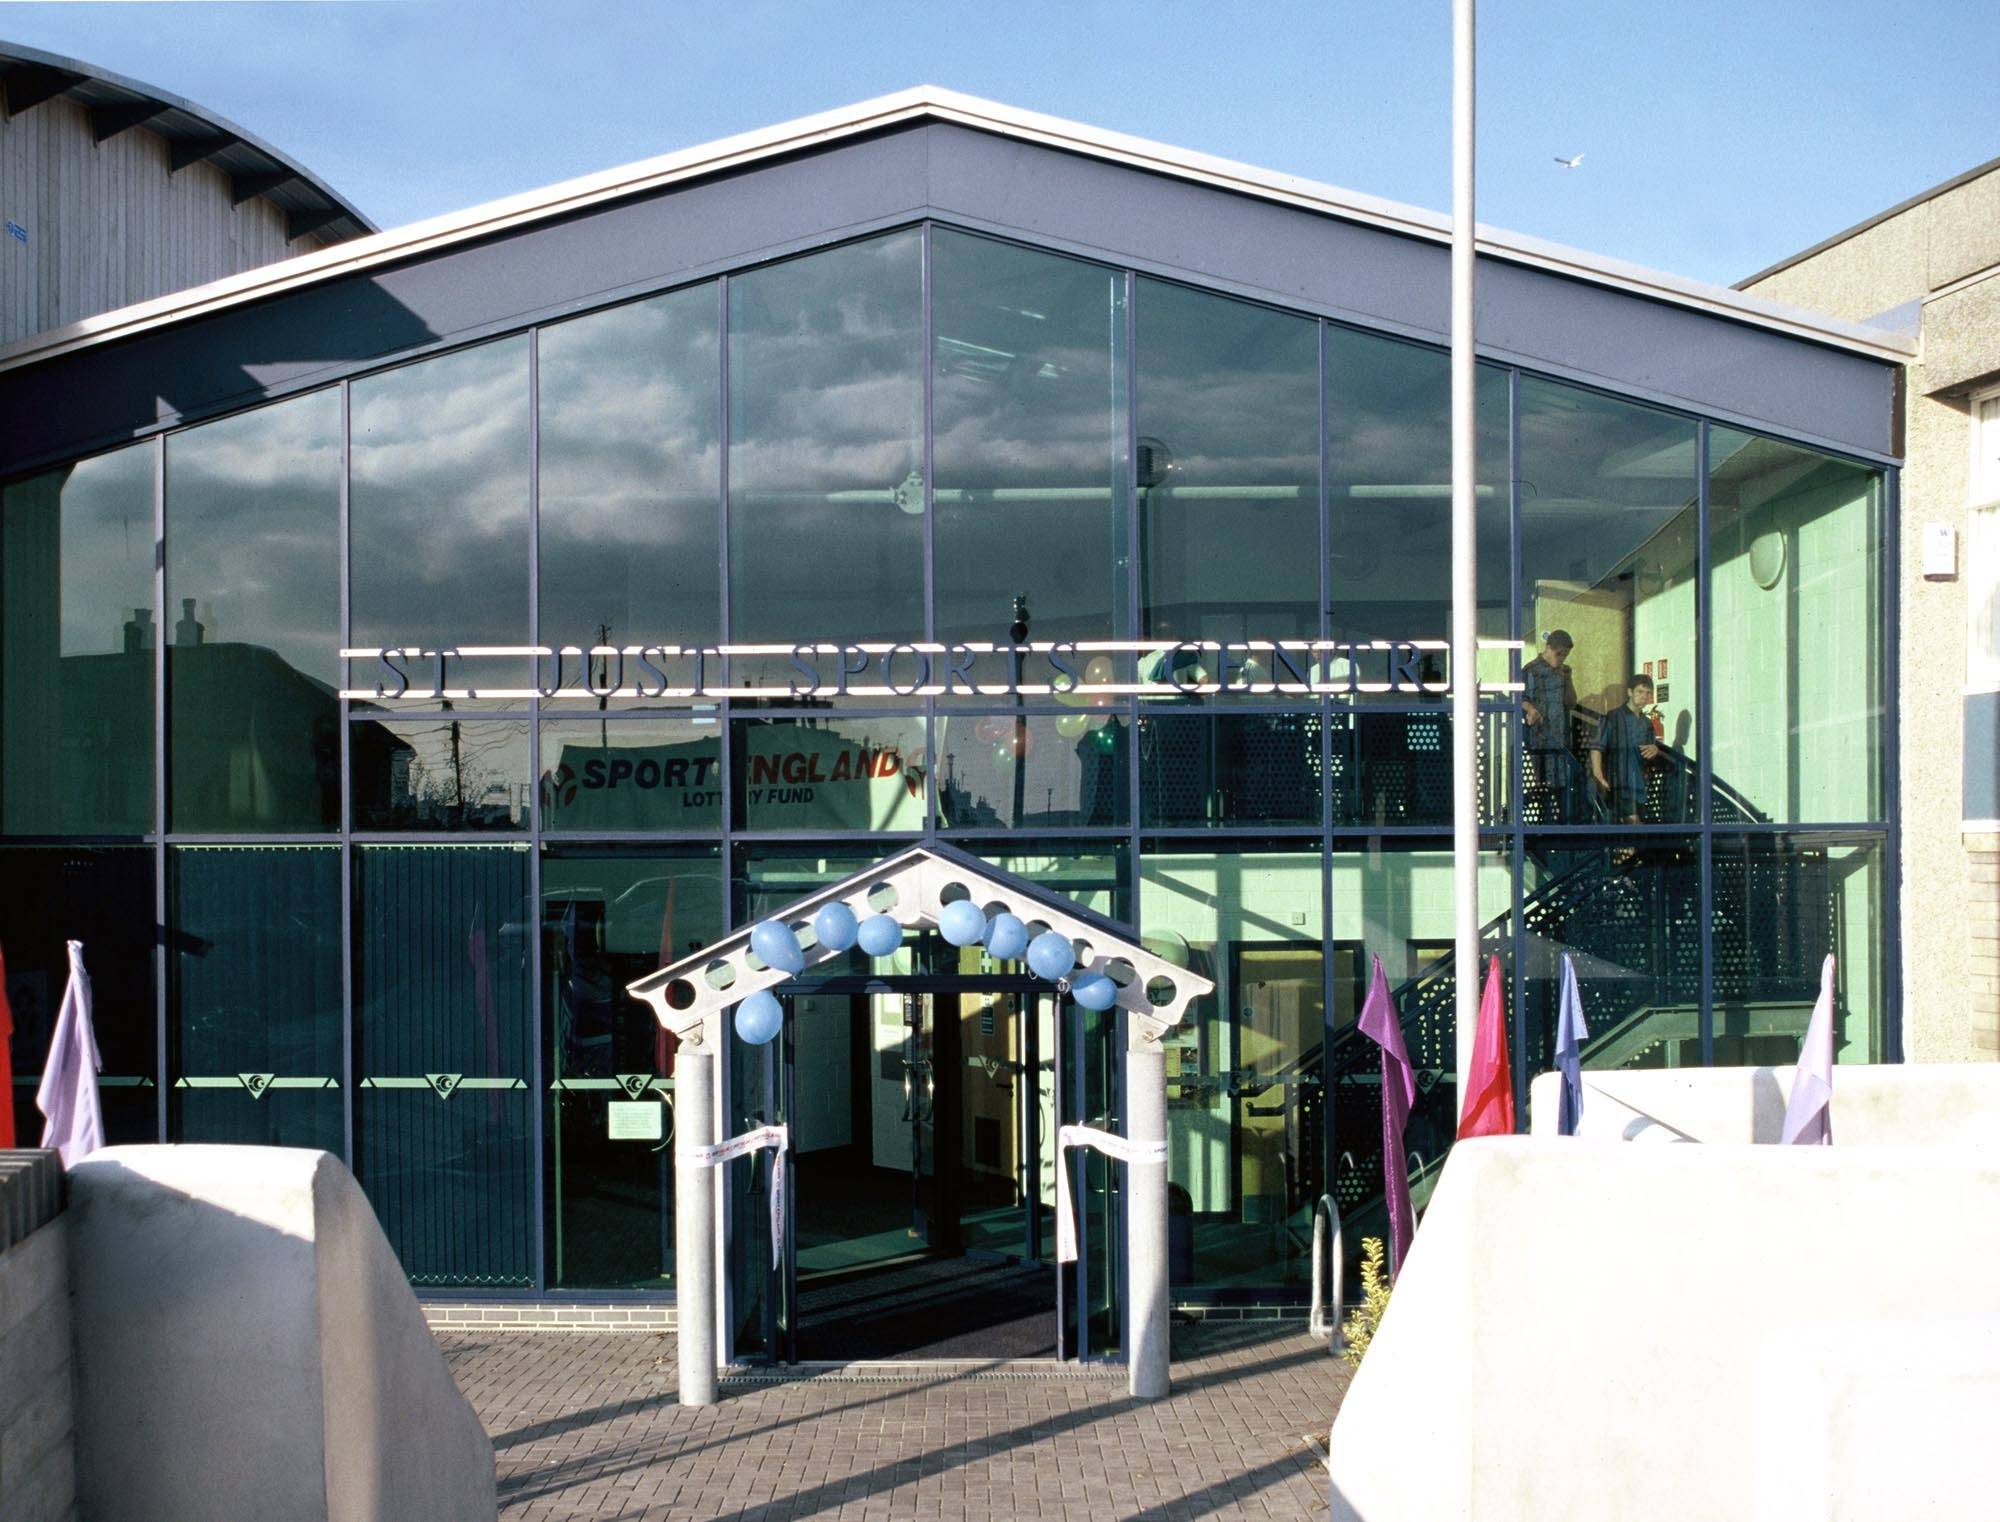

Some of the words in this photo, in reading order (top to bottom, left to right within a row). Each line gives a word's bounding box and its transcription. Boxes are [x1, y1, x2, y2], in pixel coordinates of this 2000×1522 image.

[376, 647, 477, 698] ST.
[537, 646, 722, 697] JUST
[789, 643, 1079, 696] SPORTS
[581, 756, 717, 790] SPORT
[767, 788, 814, 805] FUND
